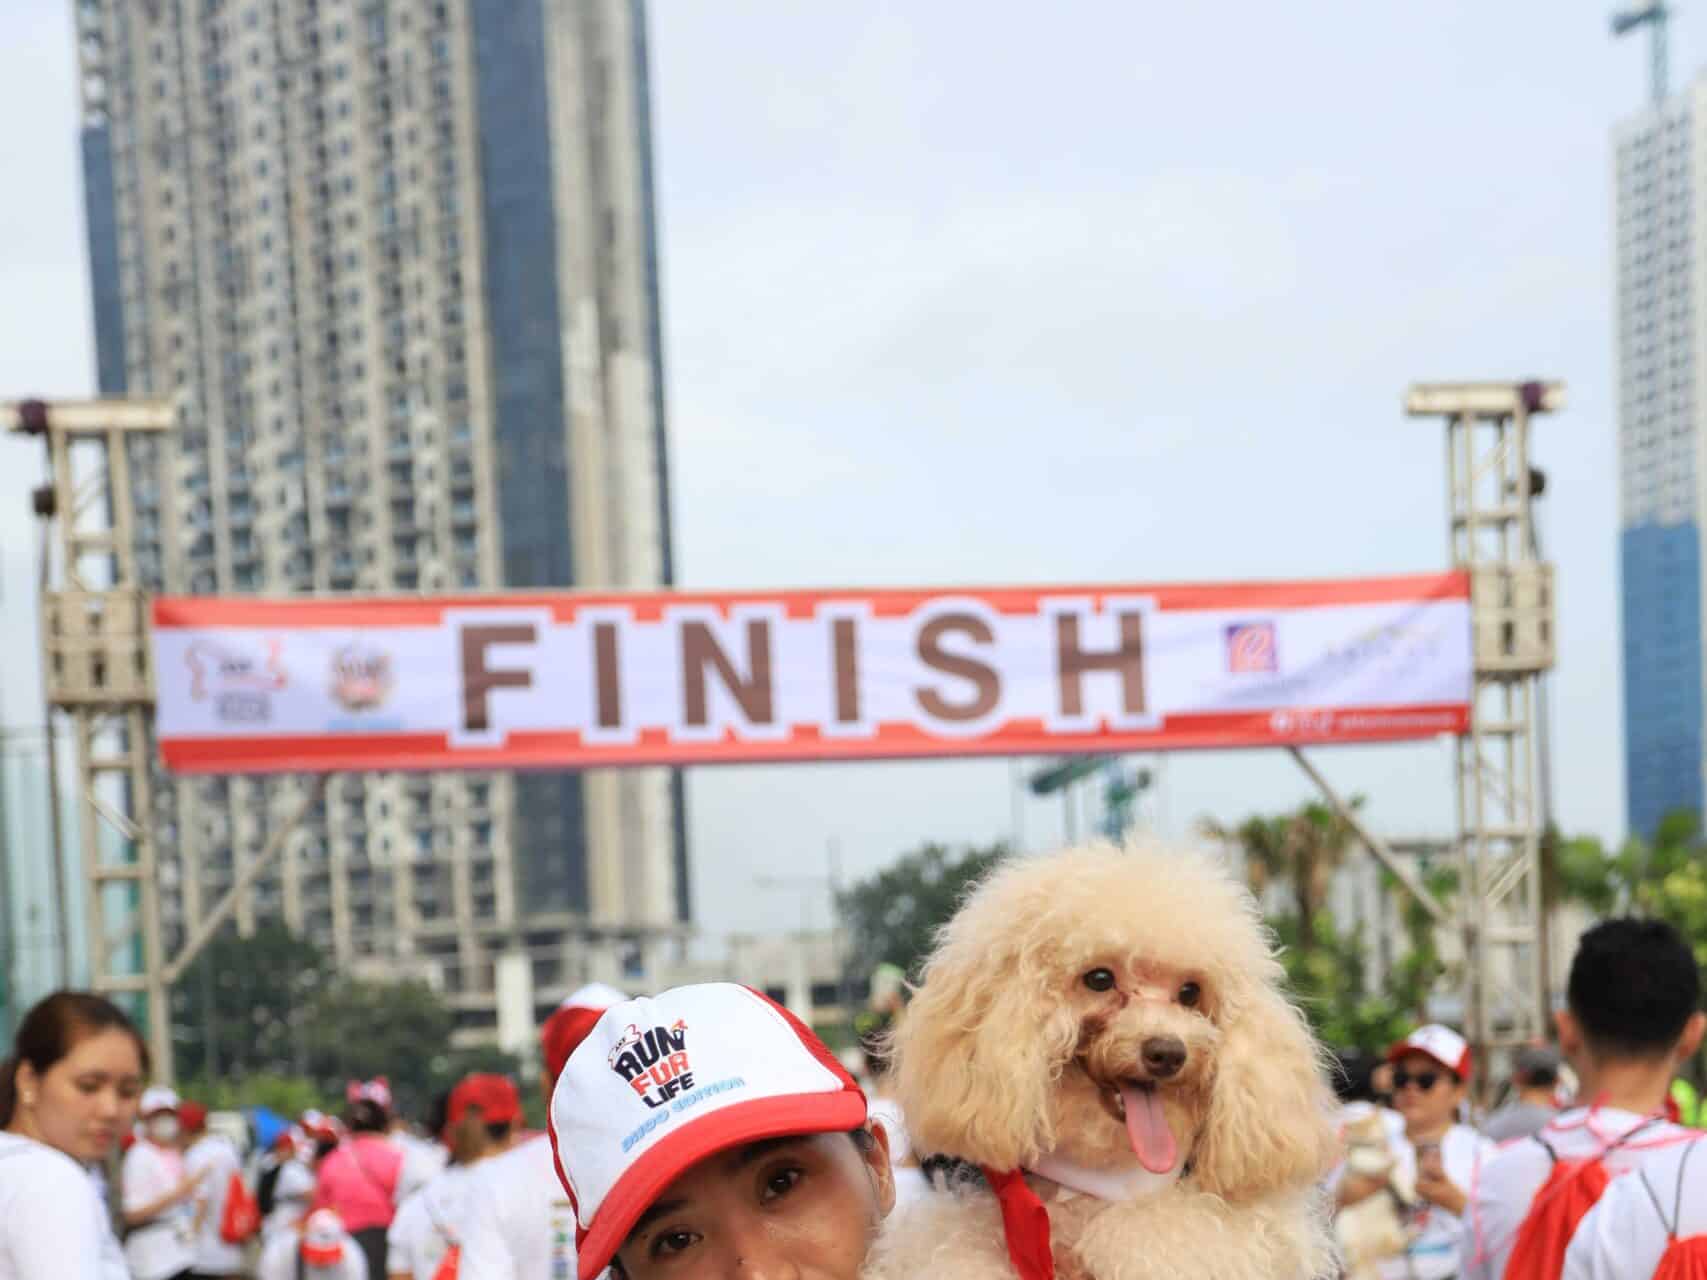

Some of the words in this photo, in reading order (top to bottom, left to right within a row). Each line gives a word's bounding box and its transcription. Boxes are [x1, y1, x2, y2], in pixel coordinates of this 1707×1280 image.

[457, 610, 1148, 732] FINISH
[613, 1026, 686, 1082] RUN
[630, 1051, 689, 1096] FUR
[641, 1072, 695, 1108] LIFE
